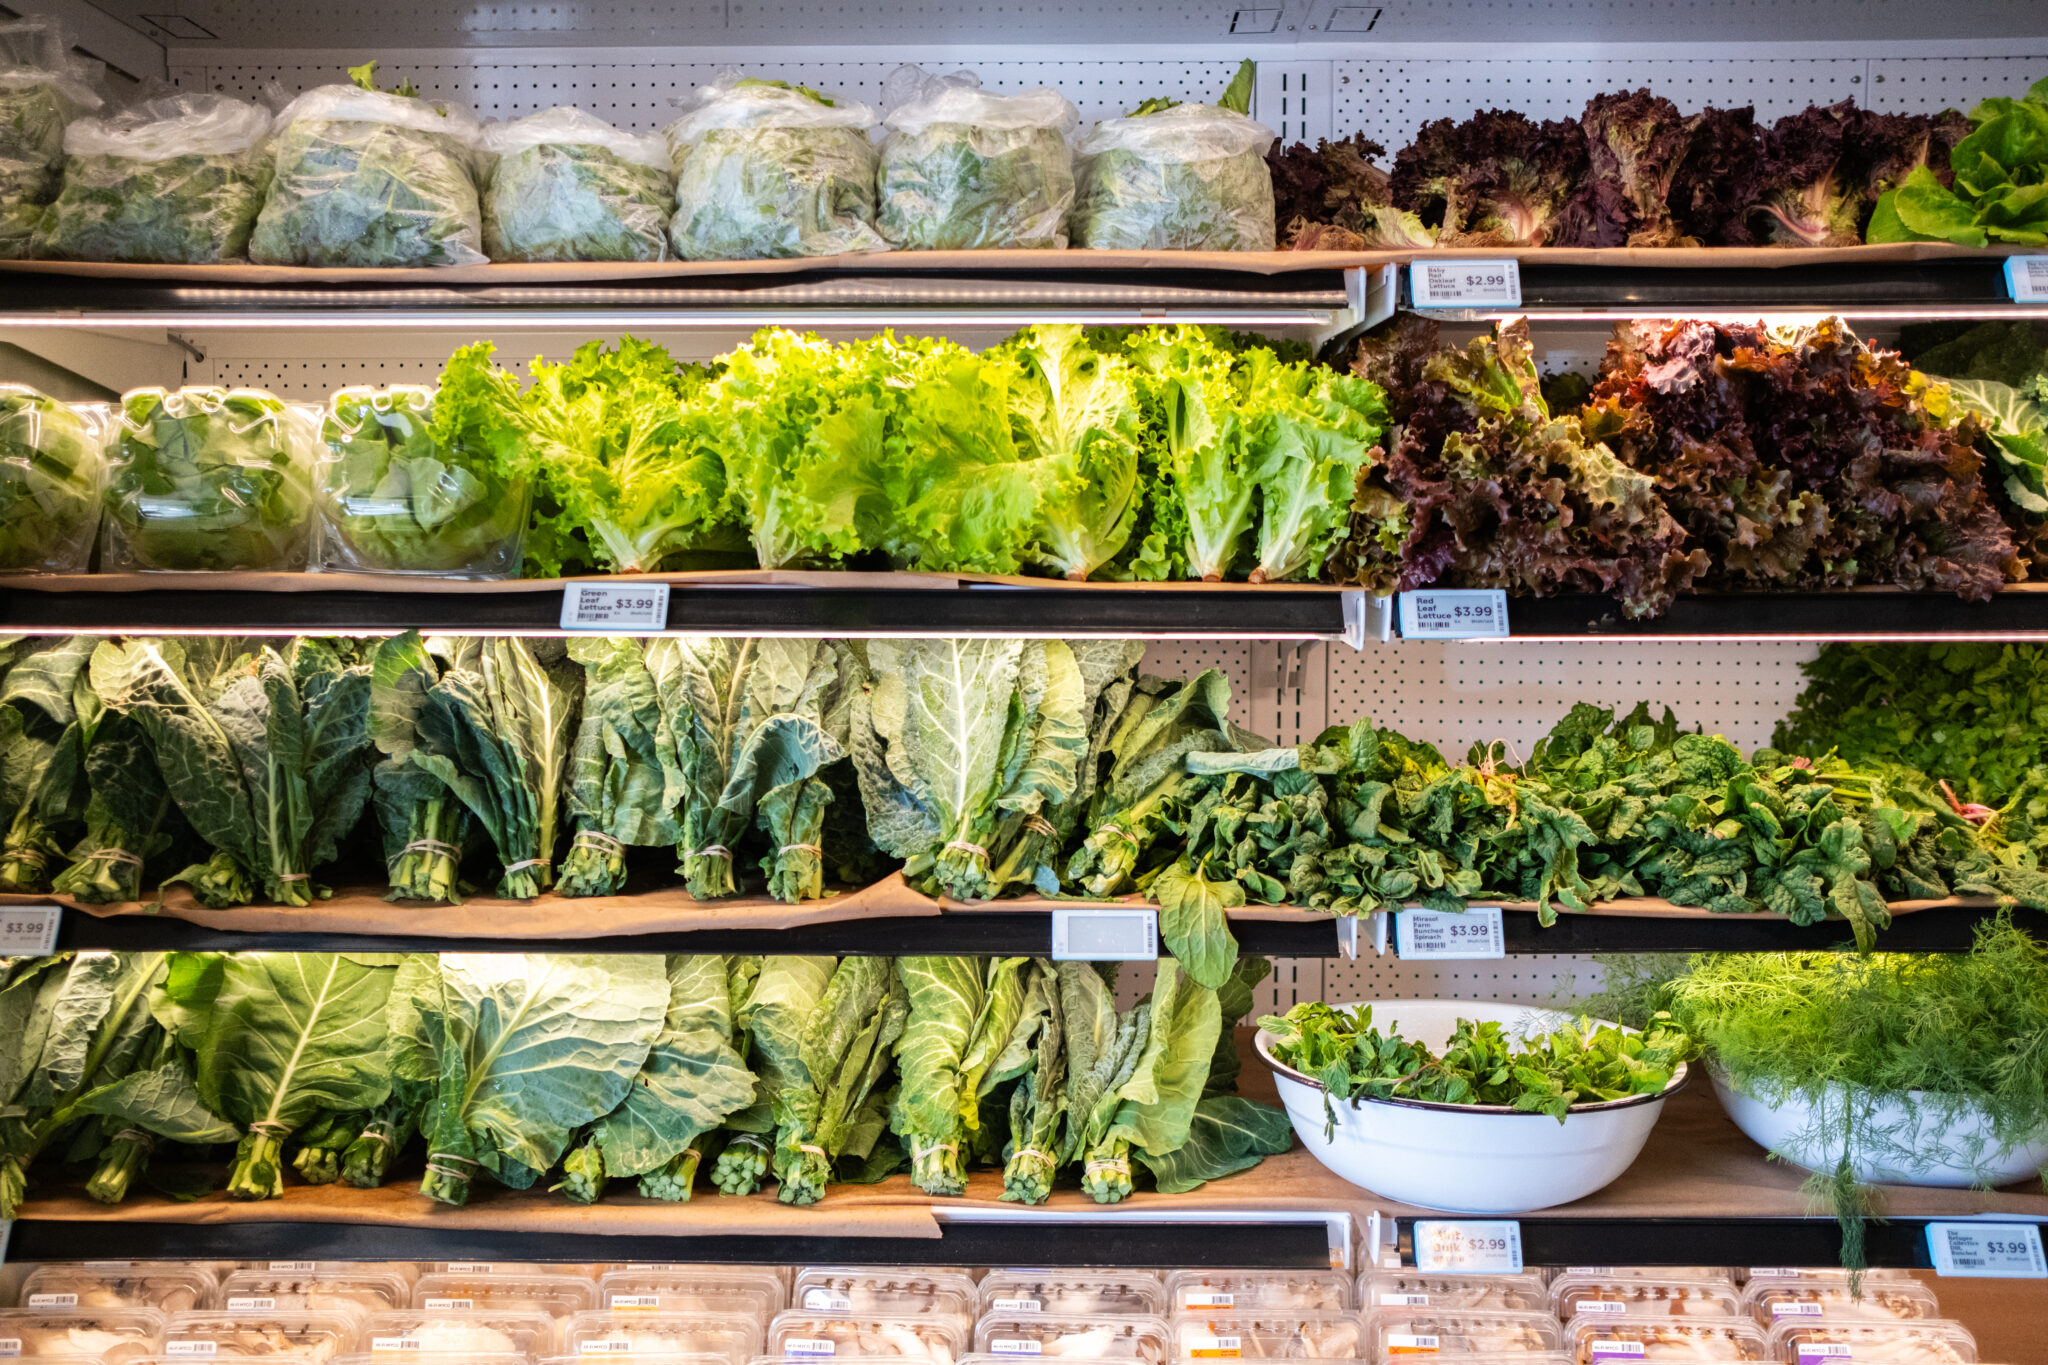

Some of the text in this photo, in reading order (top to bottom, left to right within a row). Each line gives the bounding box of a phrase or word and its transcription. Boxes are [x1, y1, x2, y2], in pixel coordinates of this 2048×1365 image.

[1466, 275, 1505, 286] $2.99
[615, 598, 653, 609] $3.99
[1454, 606, 1492, 617] $3.99
[6, 922, 44, 933] $3.99
[1450, 925, 1488, 936] $3.99
[1469, 1239, 1506, 1250] $2.99
[1987, 1242, 2027, 1254] $3.99
